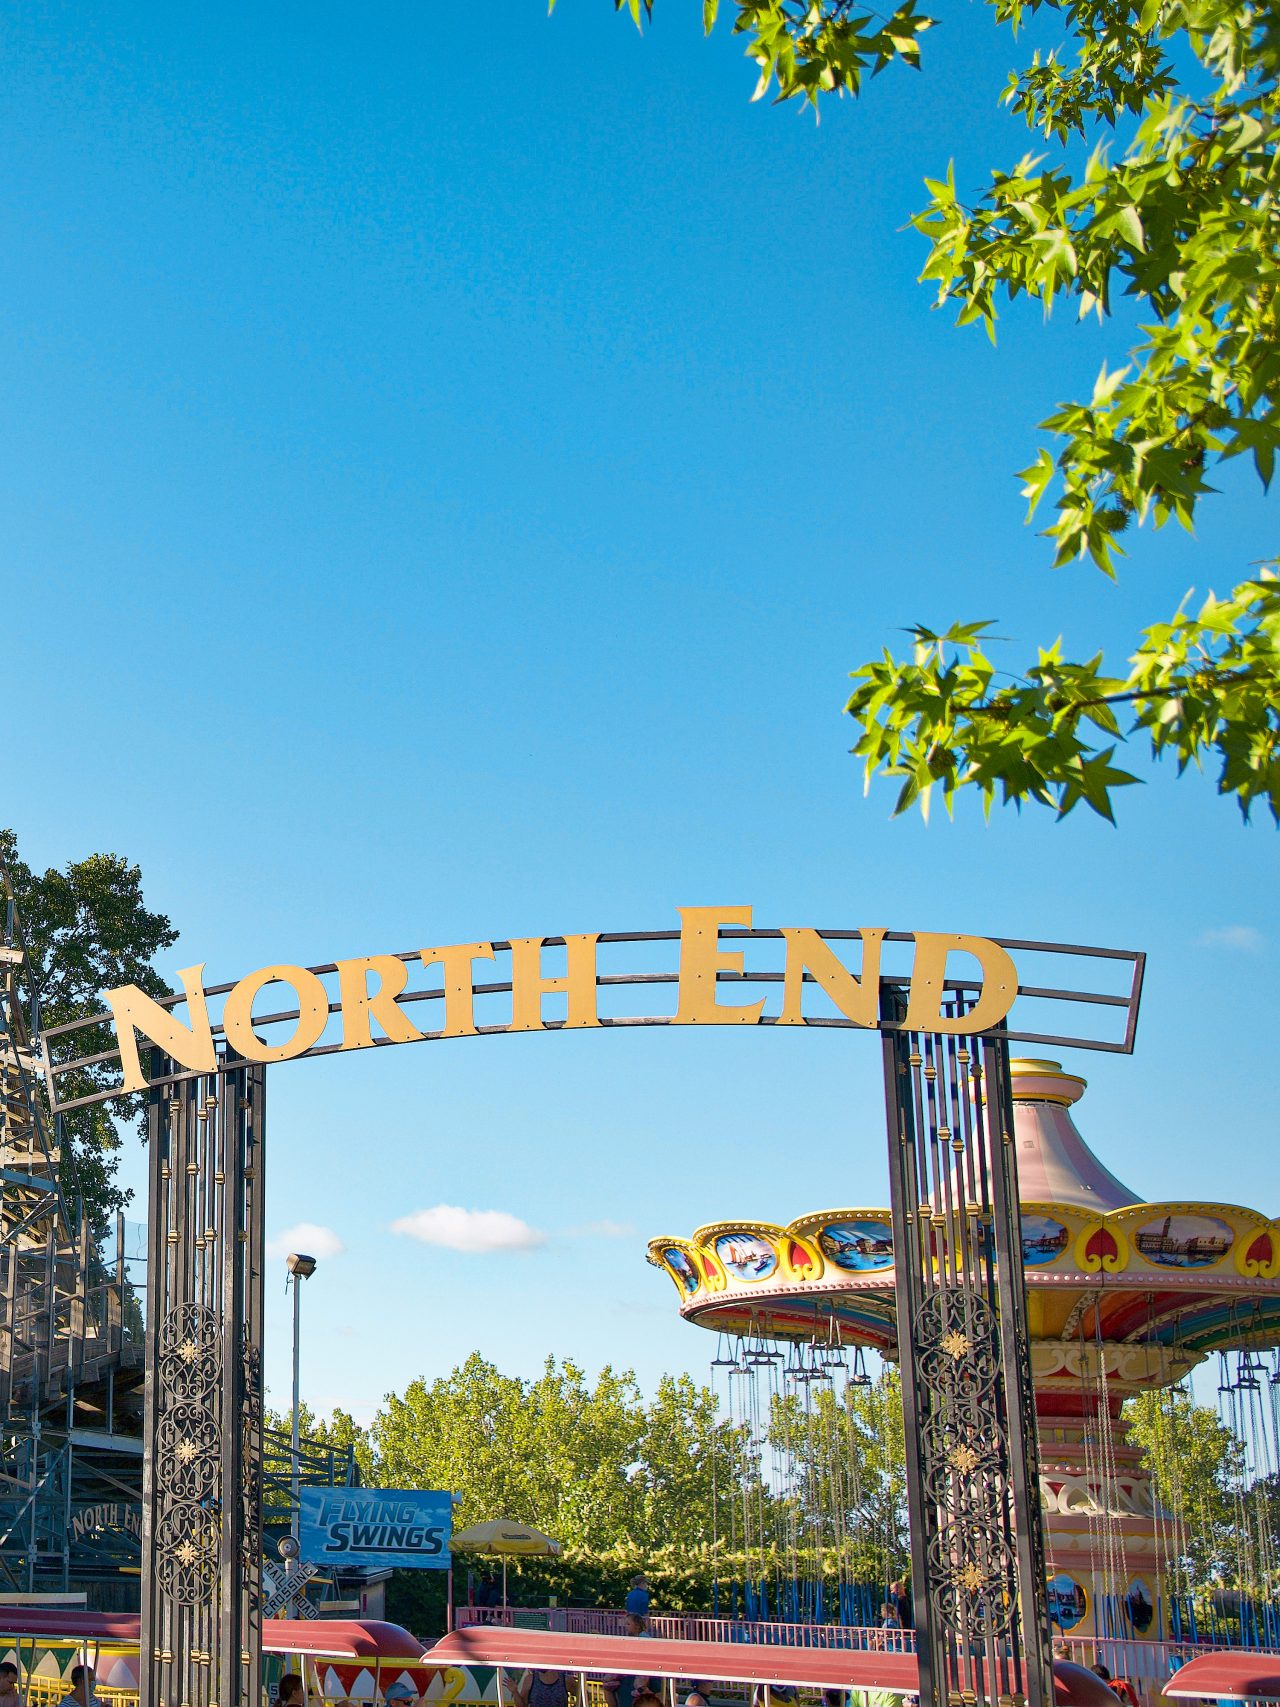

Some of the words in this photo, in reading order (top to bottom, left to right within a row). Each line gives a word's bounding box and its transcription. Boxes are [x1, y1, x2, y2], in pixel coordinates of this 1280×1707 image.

[102, 932, 603, 1095] NORTH
[668, 904, 1019, 1035] END
[72, 1503, 118, 1542] NORTH
[124, 1503, 142, 1541] EN
[318, 1497, 417, 1527] FLYING
[325, 1523, 445, 1554] SWINGS
[262, 1565, 313, 1617] CROSSING
[264, 1562, 287, 1587] RAIL
[292, 1593, 317, 1619] ROAD
